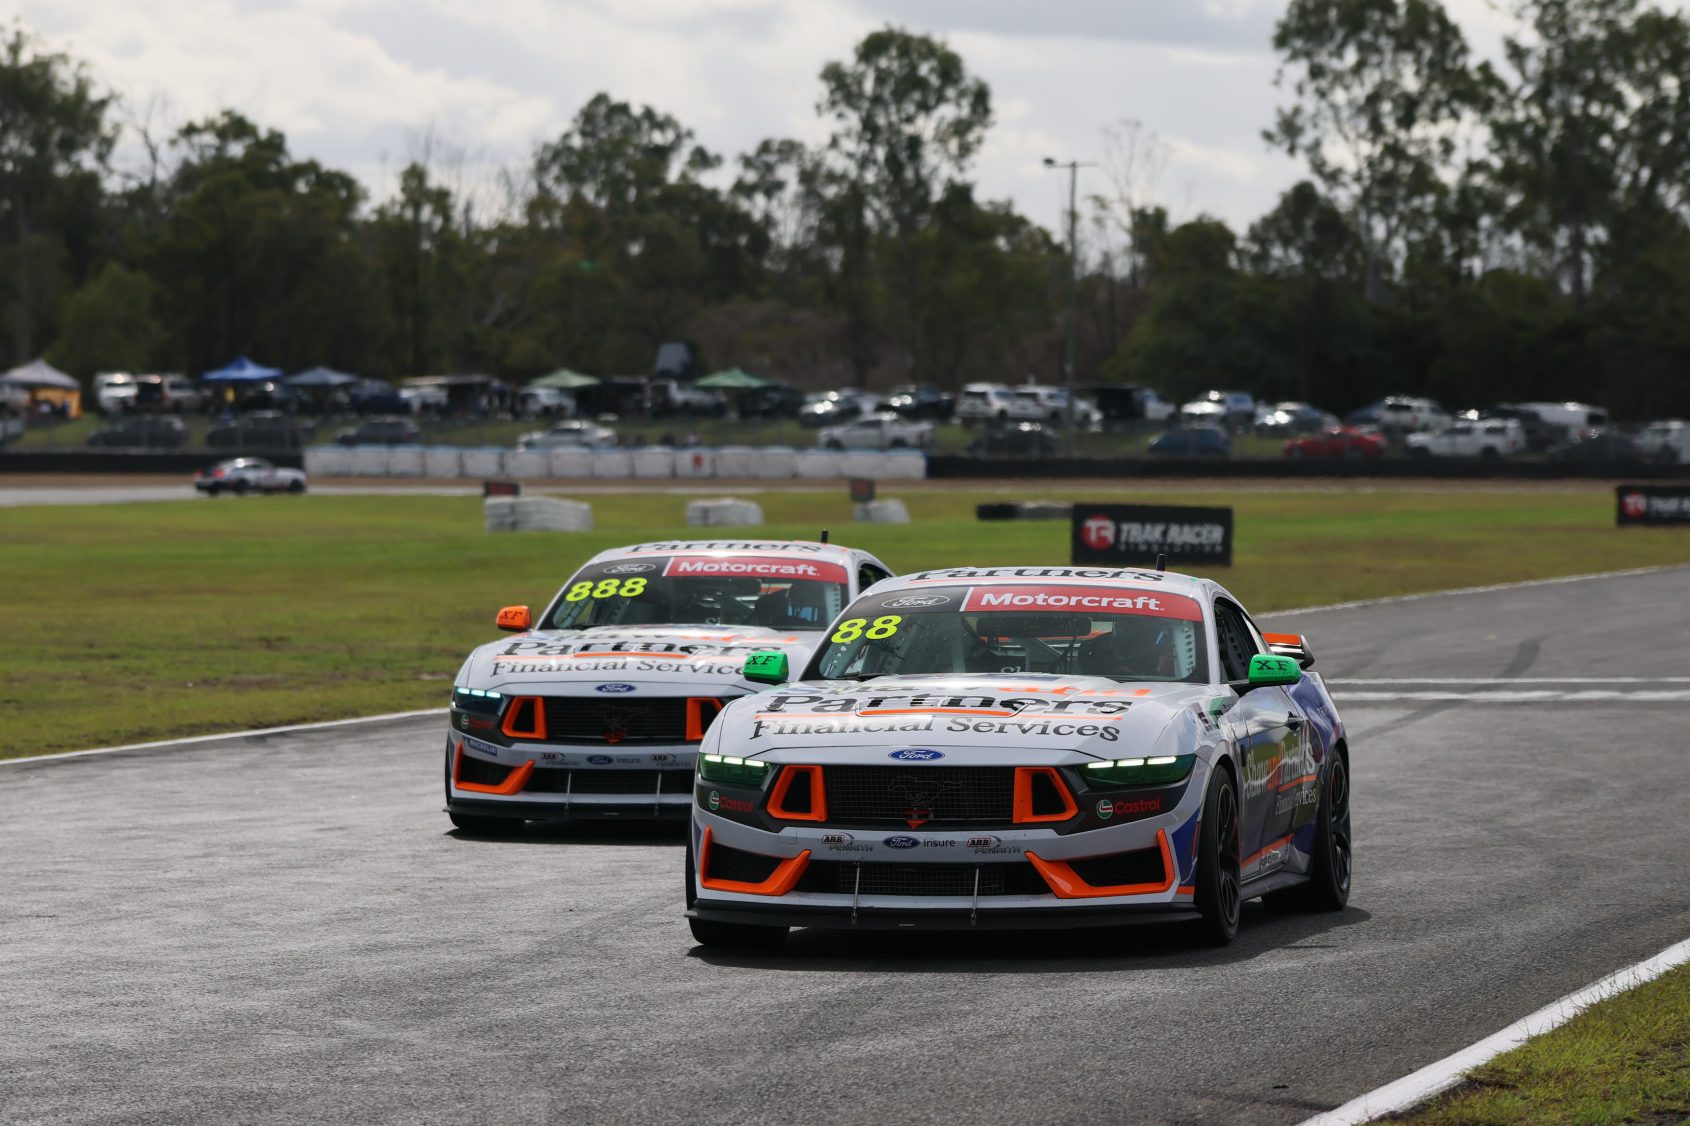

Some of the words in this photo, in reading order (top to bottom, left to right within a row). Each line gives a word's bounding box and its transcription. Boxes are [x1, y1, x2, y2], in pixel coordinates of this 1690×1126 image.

[1119, 522, 1166, 545] TRAK
[1166, 523, 1224, 546] RACER
[678, 561, 817, 576] Motorcraft
[566, 577, 647, 602] 888
[899, 597, 936, 608] Ford
[980, 592, 1160, 611] Motorcraft
[831, 615, 902, 643] 88
[490, 660, 630, 677] Financial
[636, 660, 745, 675] Servic
[747, 655, 776, 666] XF
[1255, 659, 1290, 671] XF
[757, 693, 1133, 715] Partners
[749, 717, 934, 740] Financial
[947, 718, 1121, 742] Services
[898, 751, 935, 761] Ford
[720, 796, 754, 812] Castrol
[1114, 798, 1160, 815] Castrol
